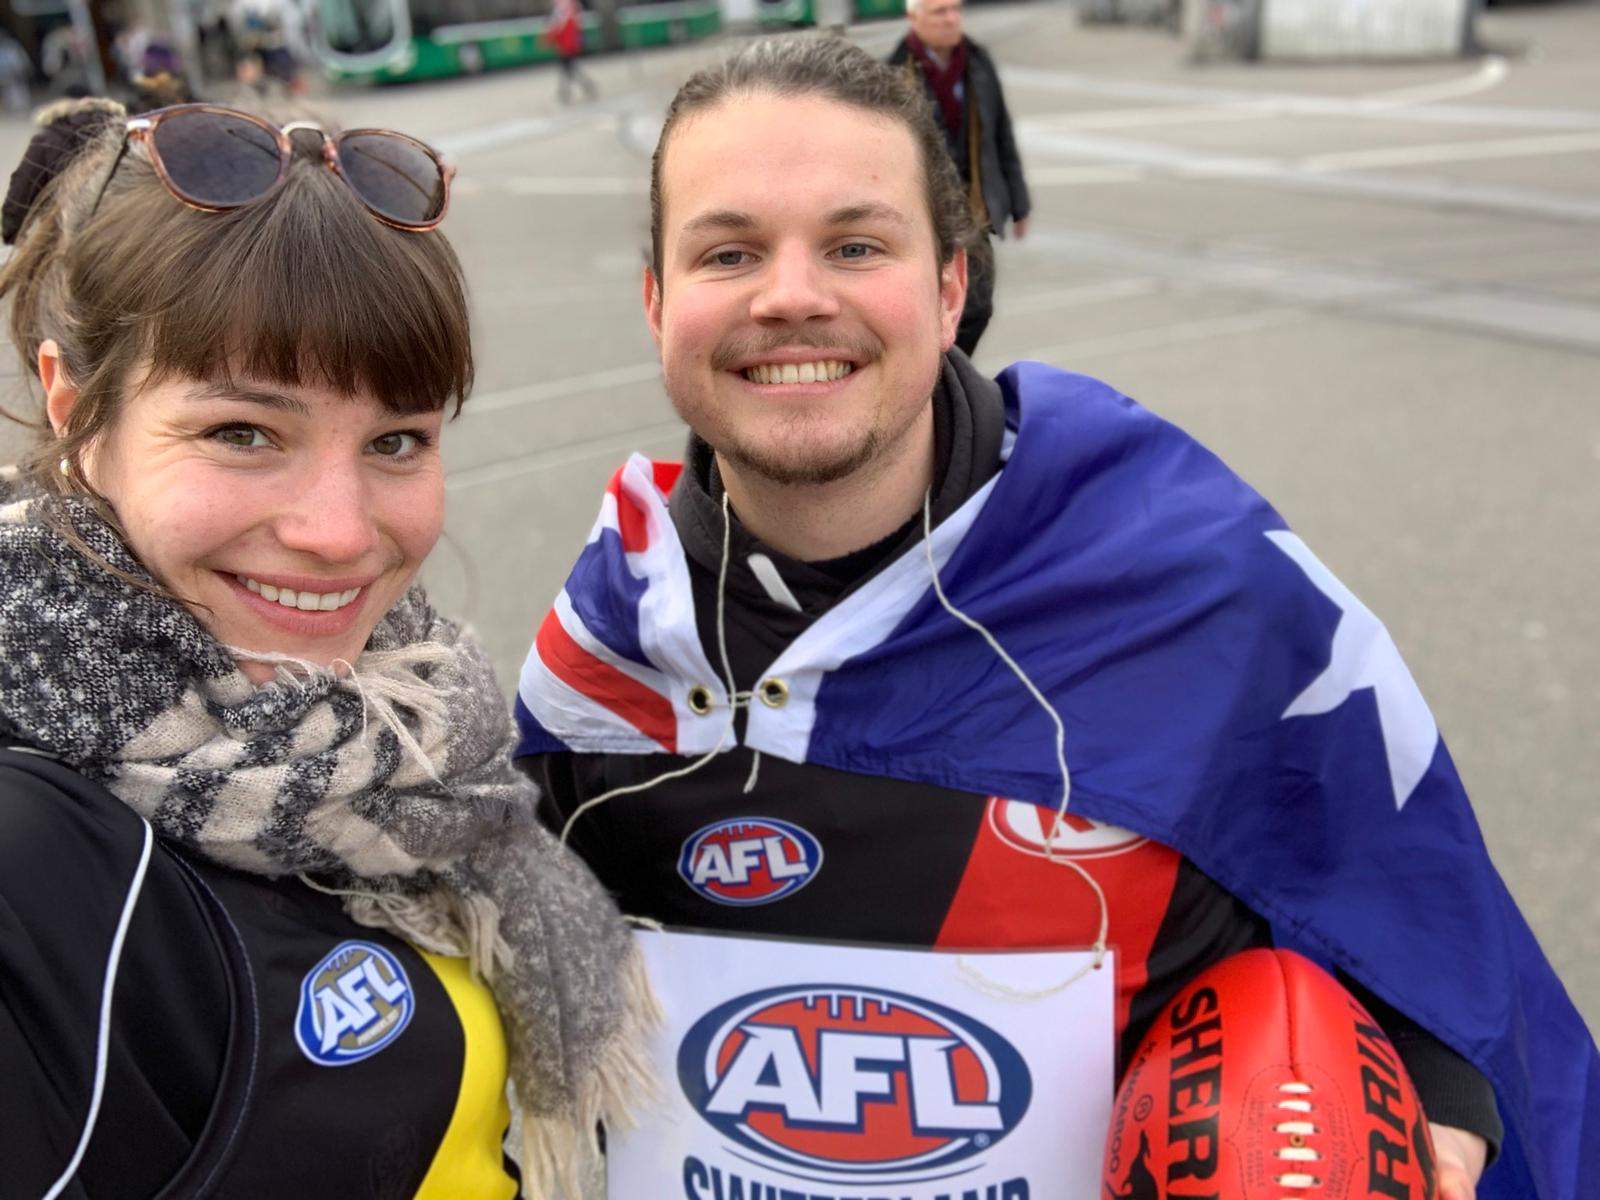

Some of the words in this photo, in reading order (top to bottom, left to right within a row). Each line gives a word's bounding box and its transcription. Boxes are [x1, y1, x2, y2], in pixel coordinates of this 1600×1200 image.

[692, 836, 809, 884] AFL
[314, 955, 407, 1054] AFL
[705, 1023, 1005, 1131] AFL
[1166, 987, 1223, 1200] SHER
